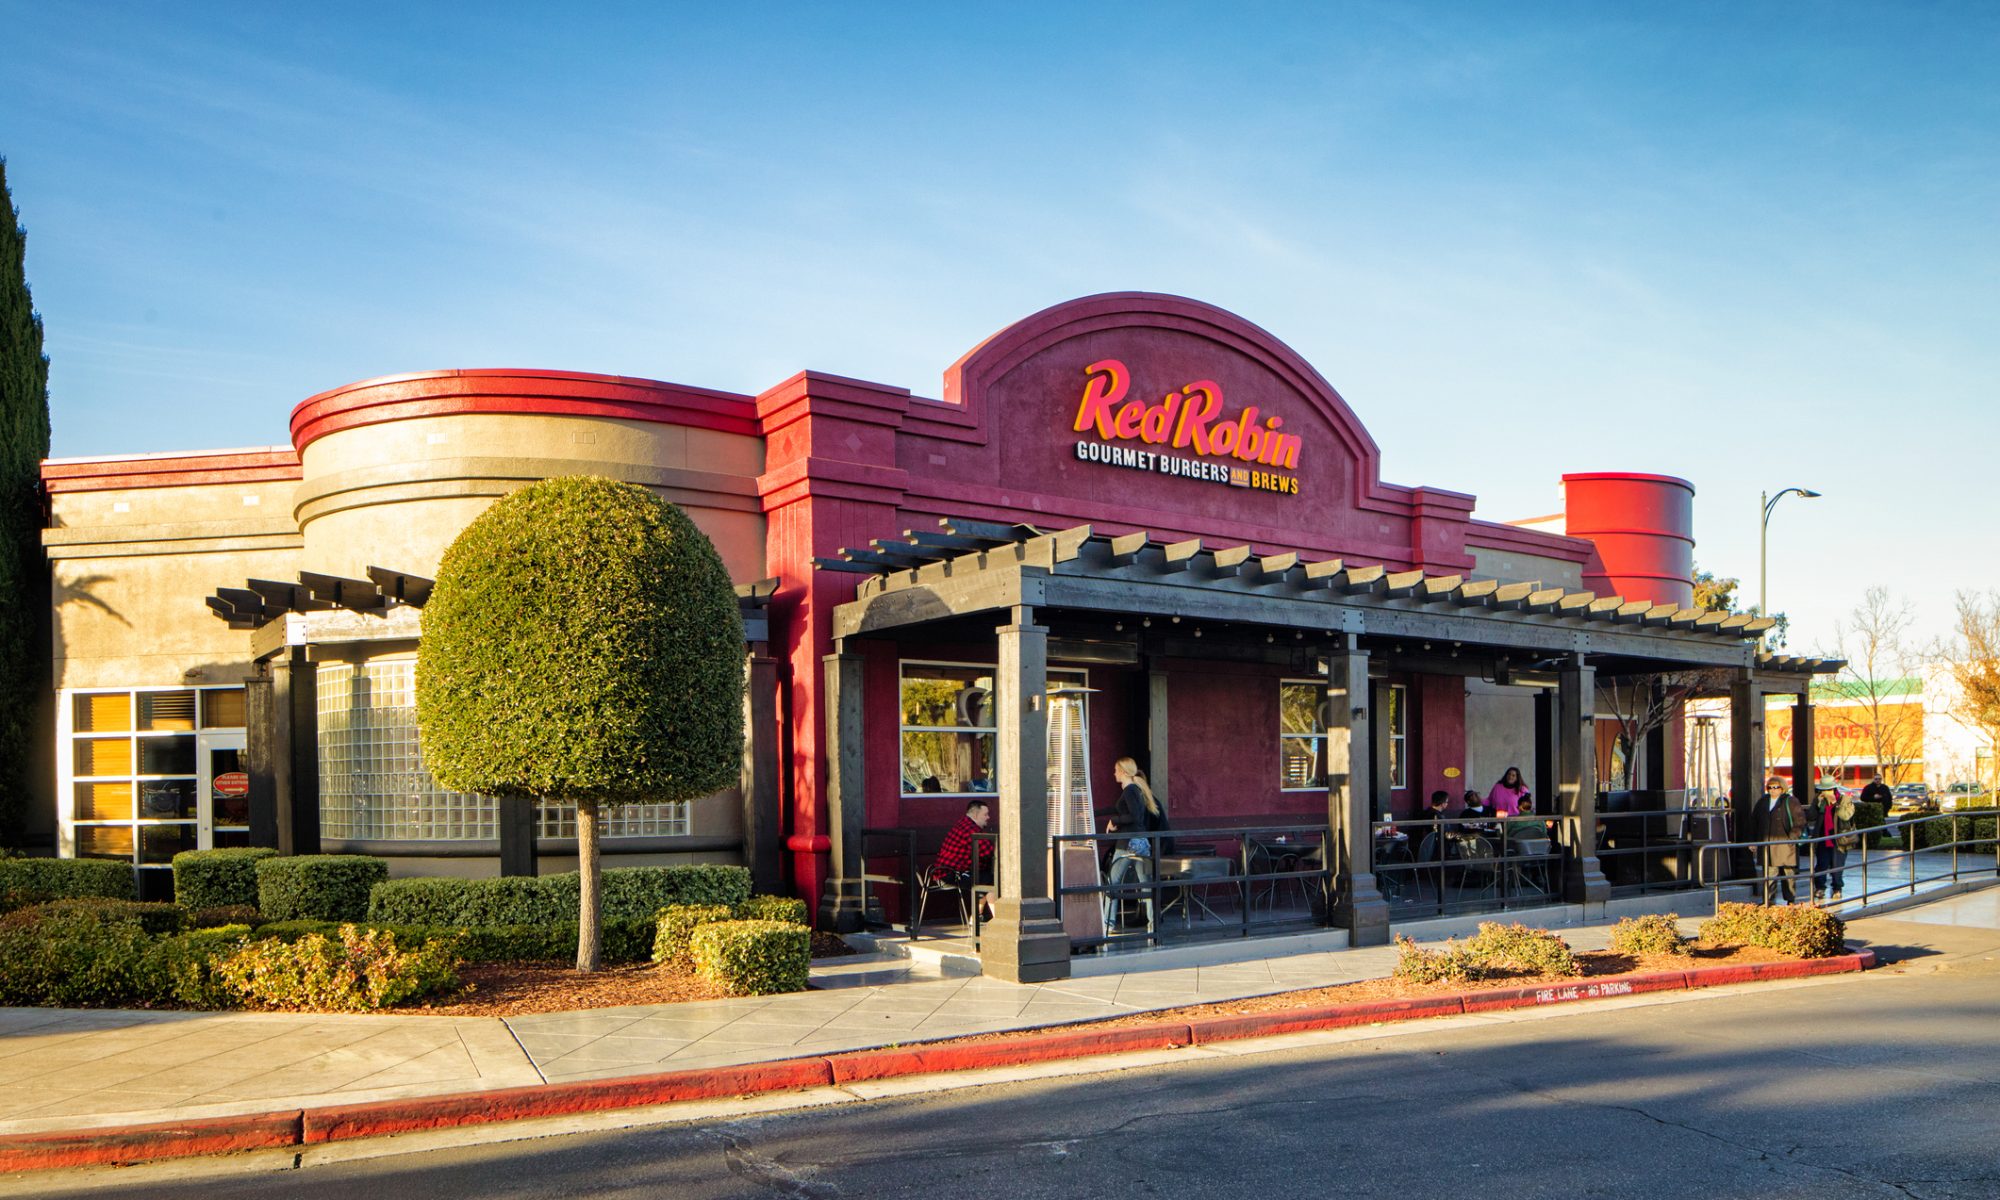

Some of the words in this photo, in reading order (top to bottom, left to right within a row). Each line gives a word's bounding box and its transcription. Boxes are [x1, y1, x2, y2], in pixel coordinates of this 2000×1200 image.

[1073, 359, 1182, 444] Red
[1172, 380, 1302, 470] Robin
[1077, 441, 1156, 471] GOURMET
[1160, 454, 1229, 483] BURGERS
[1231, 468, 1249, 482] AND
[1252, 470, 1299, 495] BREWS
[1536, 989, 1555, 1004] FIRE
[1558, 987, 1578, 1000] LANE
[1588, 985, 1599, 997] NO
[1601, 982, 1632, 996] PARKING
